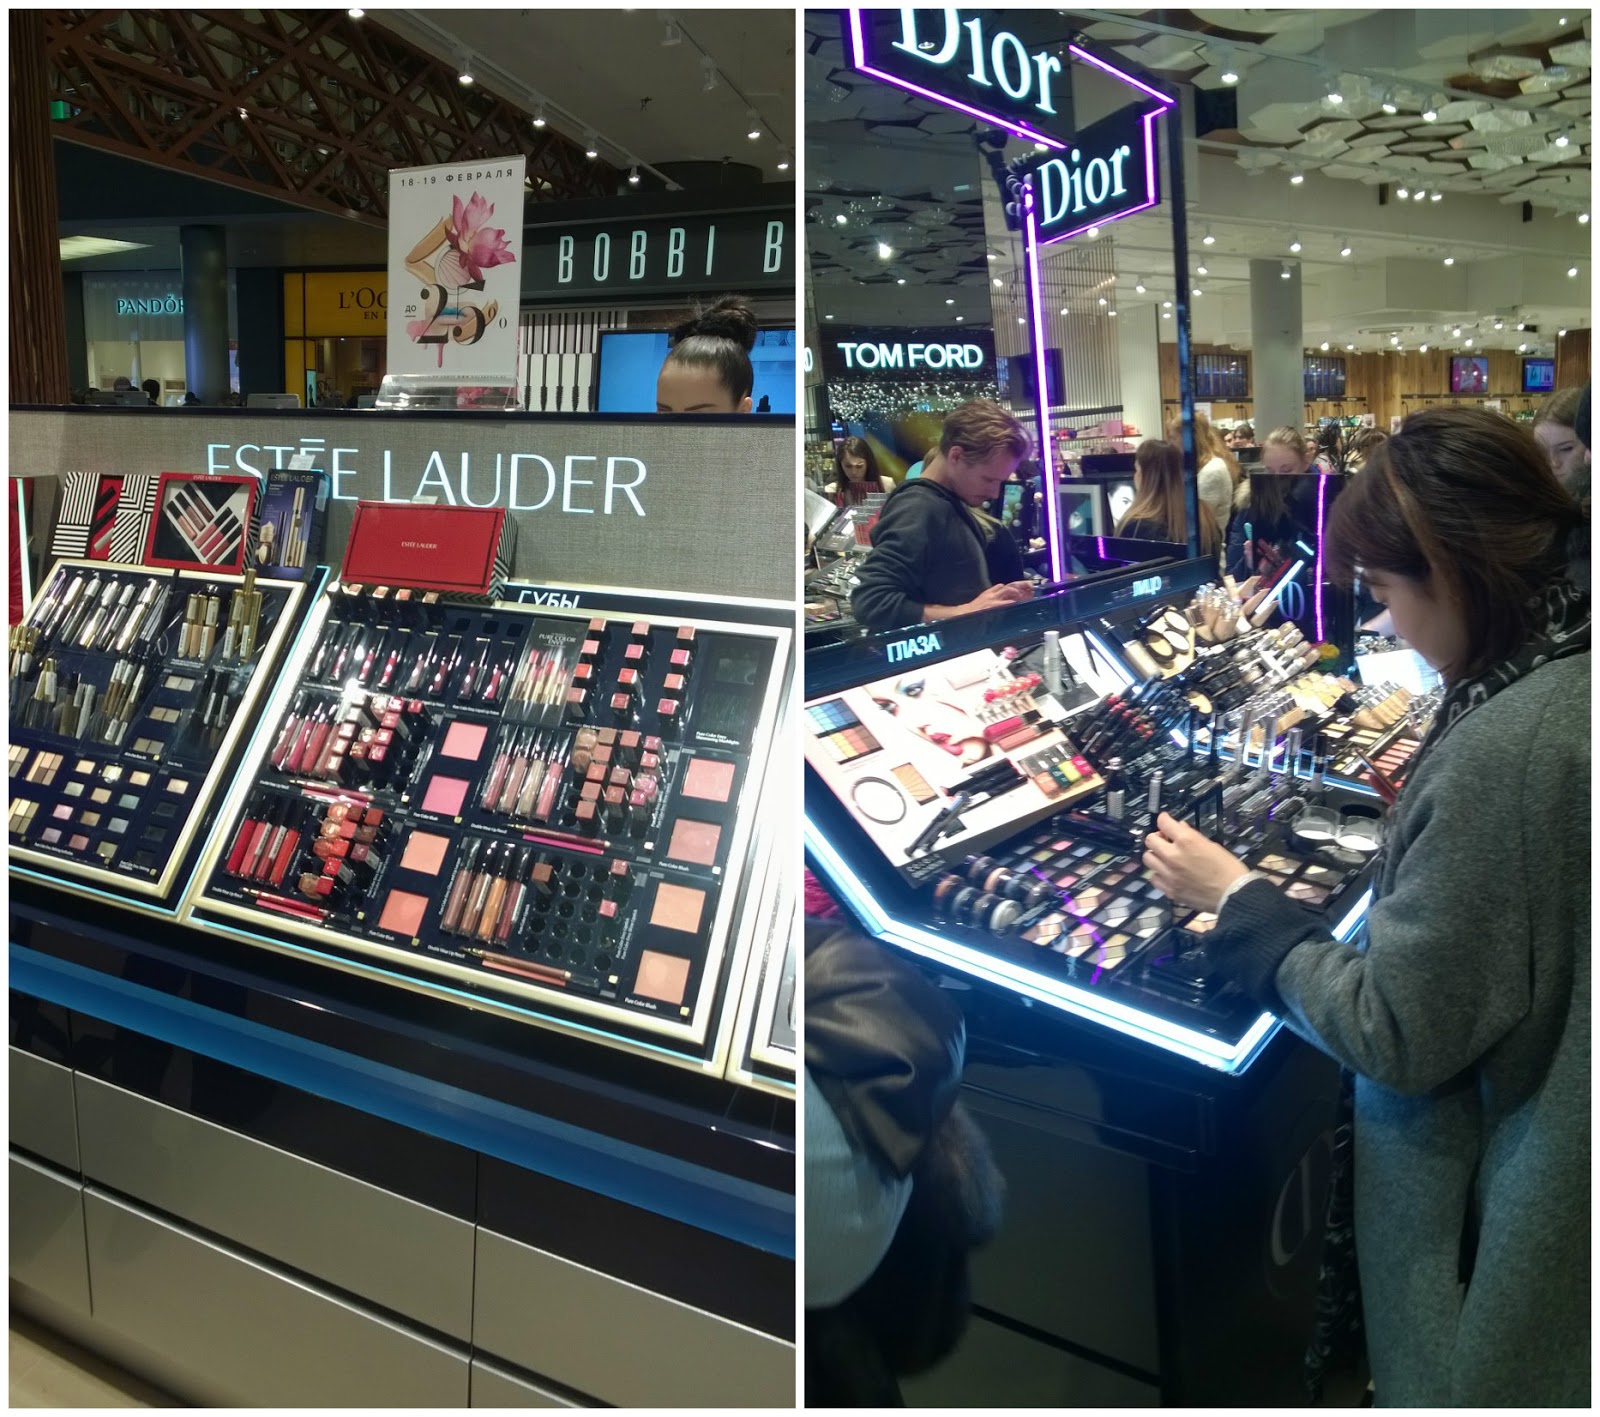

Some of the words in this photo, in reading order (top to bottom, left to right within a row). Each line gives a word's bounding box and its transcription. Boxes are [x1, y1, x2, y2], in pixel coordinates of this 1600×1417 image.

[446, 168, 513, 182] ФЕВРАЛЯ
[1036, 145, 1131, 226] Dior
[558, 225, 716, 284] BOBBI
[763, 221, 784, 273] B
[837, 343, 904, 368] TOM
[907, 343, 984, 368] FORD
[382, 450, 647, 517] LAUDER
[518, 590, 580, 609] ГУБЫ
[886, 633, 941, 663] ГЛАЗА
